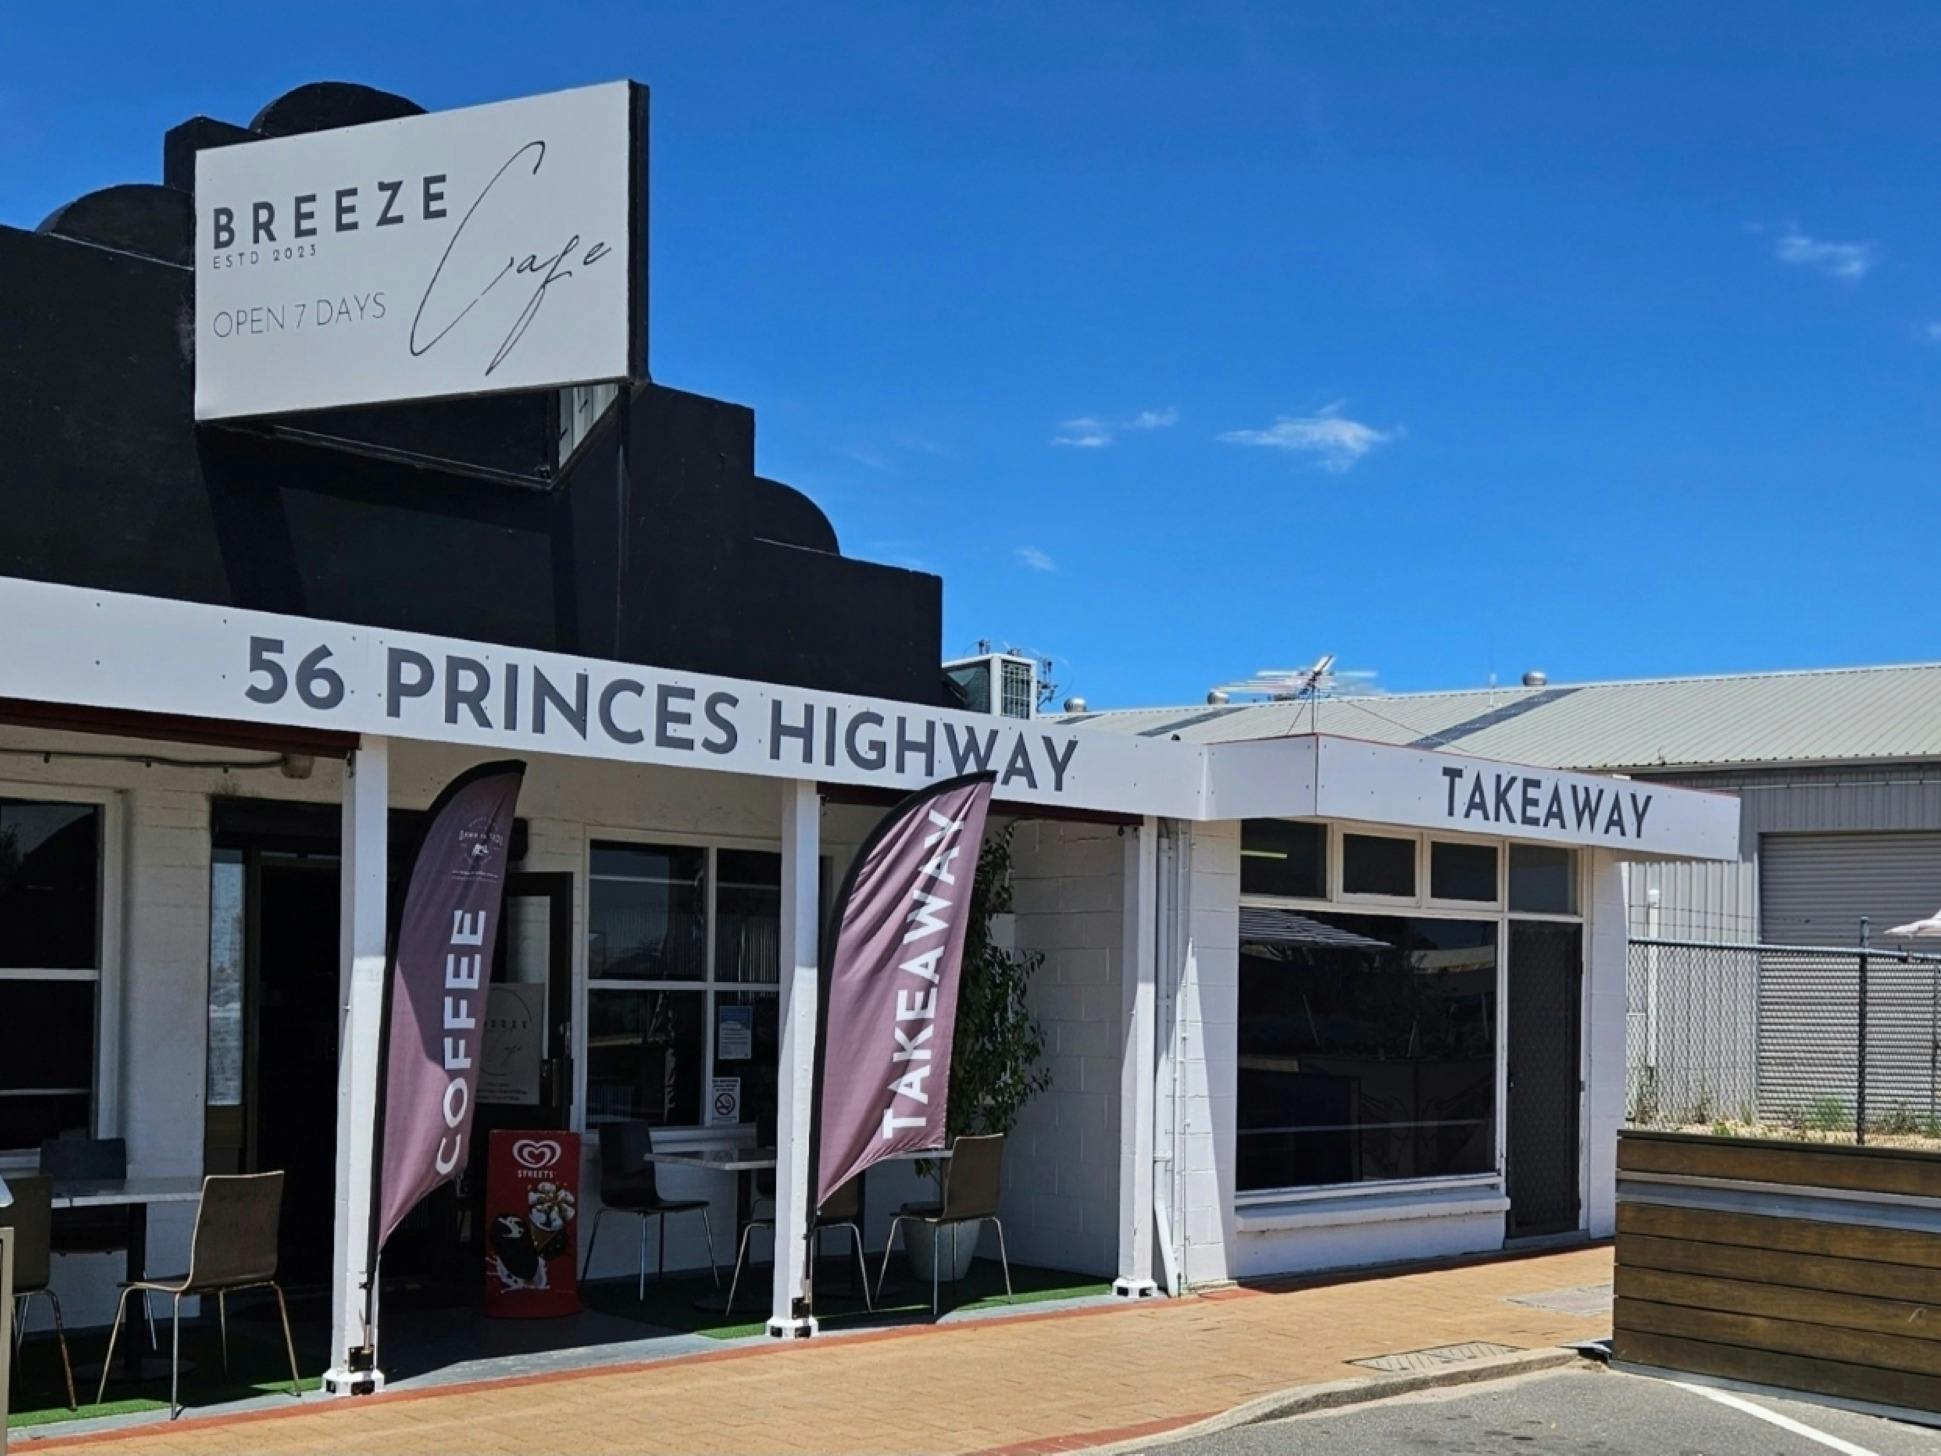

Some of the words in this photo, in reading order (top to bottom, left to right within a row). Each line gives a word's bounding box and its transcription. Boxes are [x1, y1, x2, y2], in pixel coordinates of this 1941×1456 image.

[213, 174, 447, 249] BREEZE
[213, 251, 259, 269] ESTD
[273, 244, 316, 262] 2023
[410, 140, 612, 377] Cafe
[213, 303, 285, 338] OPEN
[295, 303, 307, 329] 7
[316, 292, 387, 326] DAYS
[244, 635, 345, 710] 56
[386, 646, 740, 755] PRINCES
[769, 699, 1079, 792] HIGHWAY
[1442, 766, 1653, 839] TAKEAWAY
[883, 809, 965, 1139] TAKEAWAY
[435, 909, 486, 1175] COFFEE
[517, 1169, 554, 1179] STREETS
